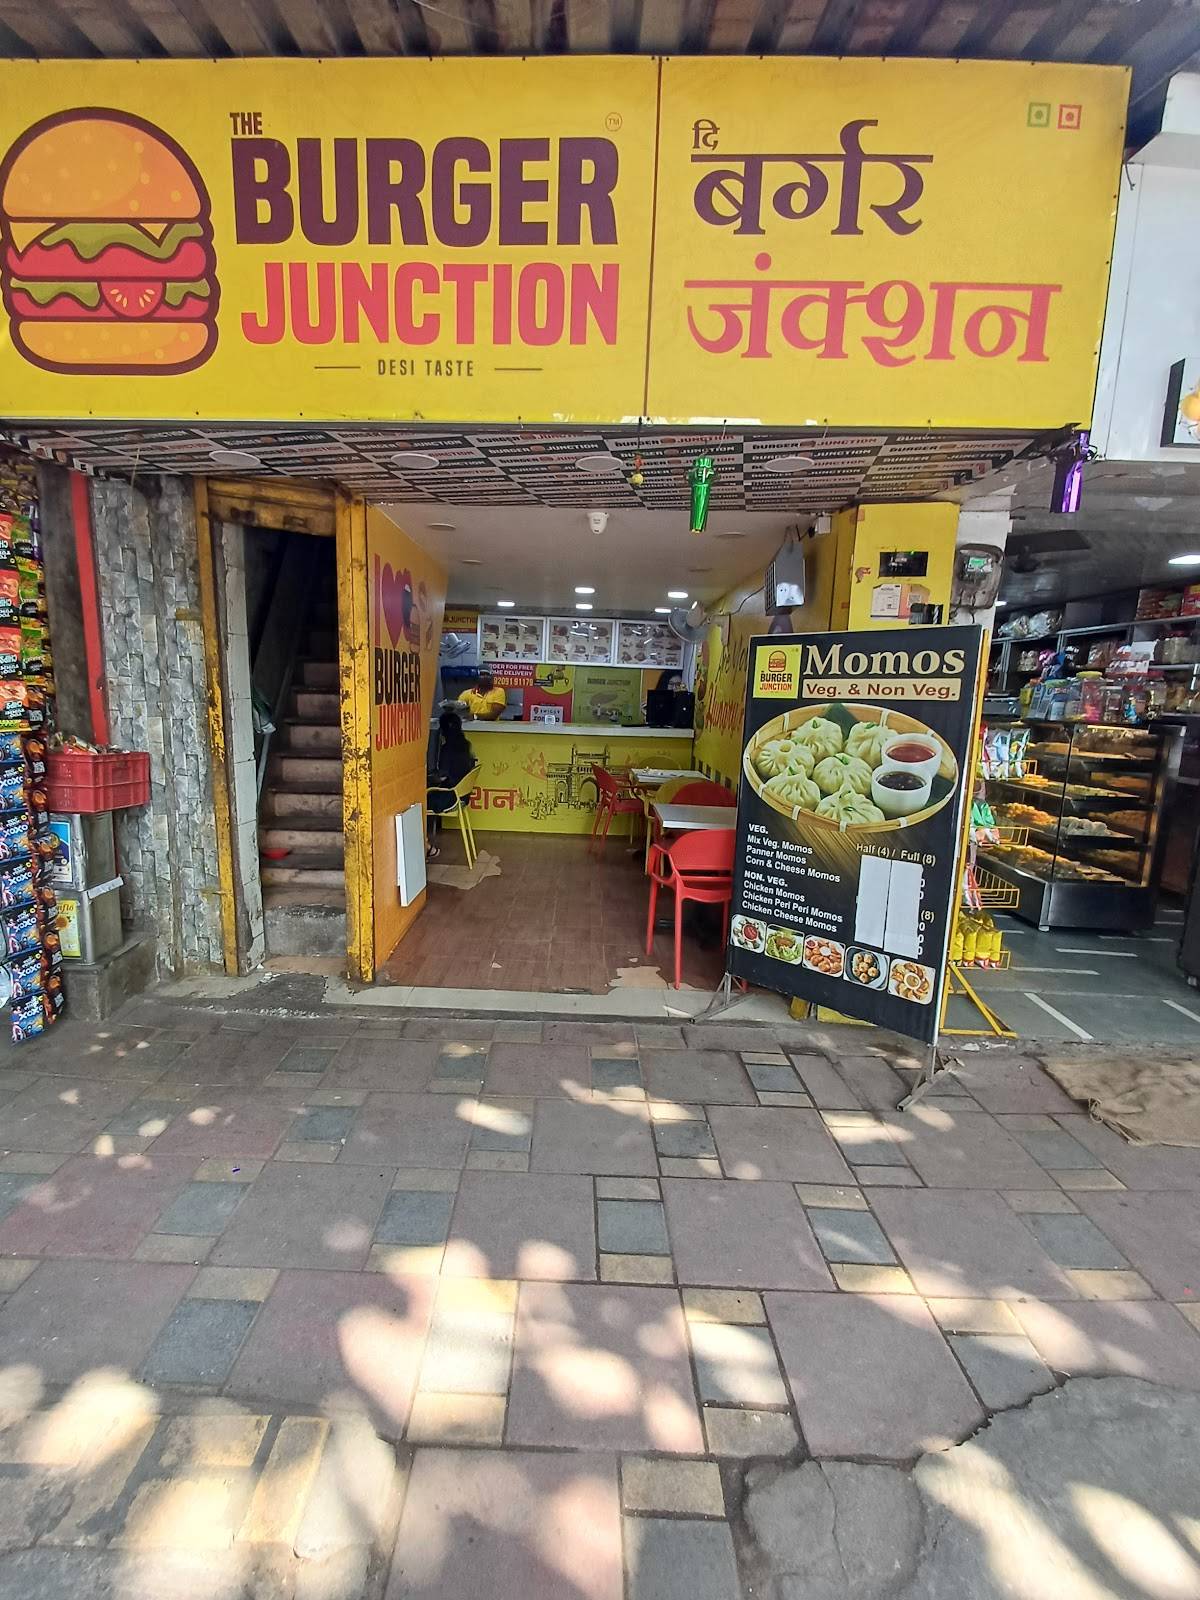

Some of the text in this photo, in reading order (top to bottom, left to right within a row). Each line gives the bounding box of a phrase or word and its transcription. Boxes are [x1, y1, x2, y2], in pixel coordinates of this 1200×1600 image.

[230, 112, 263, 139] THE
[691, 118, 720, 150] दि
[690, 119, 934, 236] बर्गर
[231, 137, 620, 246] BURGER
[241, 262, 620, 346] JUNCTION
[684, 252, 1062, 368] जंक्शन
[377, 359, 475, 378] DESI TASTE
[374, 552, 381, 648] I
[802, 643, 966, 676] Momos
[375, 646, 421, 706] BURGER
[504, 669, 533, 677] DELIVERY
[760, 673, 793, 683] BURGER
[759, 683, 793, 691] JUNCTION
[806, 682, 956, 699] Veg. & Non Veg.
[375, 703, 422, 752] JUNCTION
[3, 824, 29, 838] XOXO
[748, 823, 769, 834] VEG.
[746, 845, 807, 865] Panner Momos
[747, 834, 813, 855] Mix Veg. Momos
[856, 843, 875, 854] Half
[877, 847, 890, 858] (4)
[901, 850, 920, 861] Full
[922, 855, 936, 867] (8)
[8, 871, 33, 886] XOXO
[744, 870, 788, 888] NON. VEG.
[745, 855, 841, 883] Corn & Cheese Momos
[743, 880, 806, 903] Chicken Momos
[742, 900, 838, 933] Chicken Cheese Momos
[743, 890, 844, 923] Chicken Peri Peri Momos
[920, 910, 935, 923] (8)
[15, 916, 37, 932] XOXO
[18, 962, 42, 979] XOXO
[18, 1004, 43, 1021] XOXO
